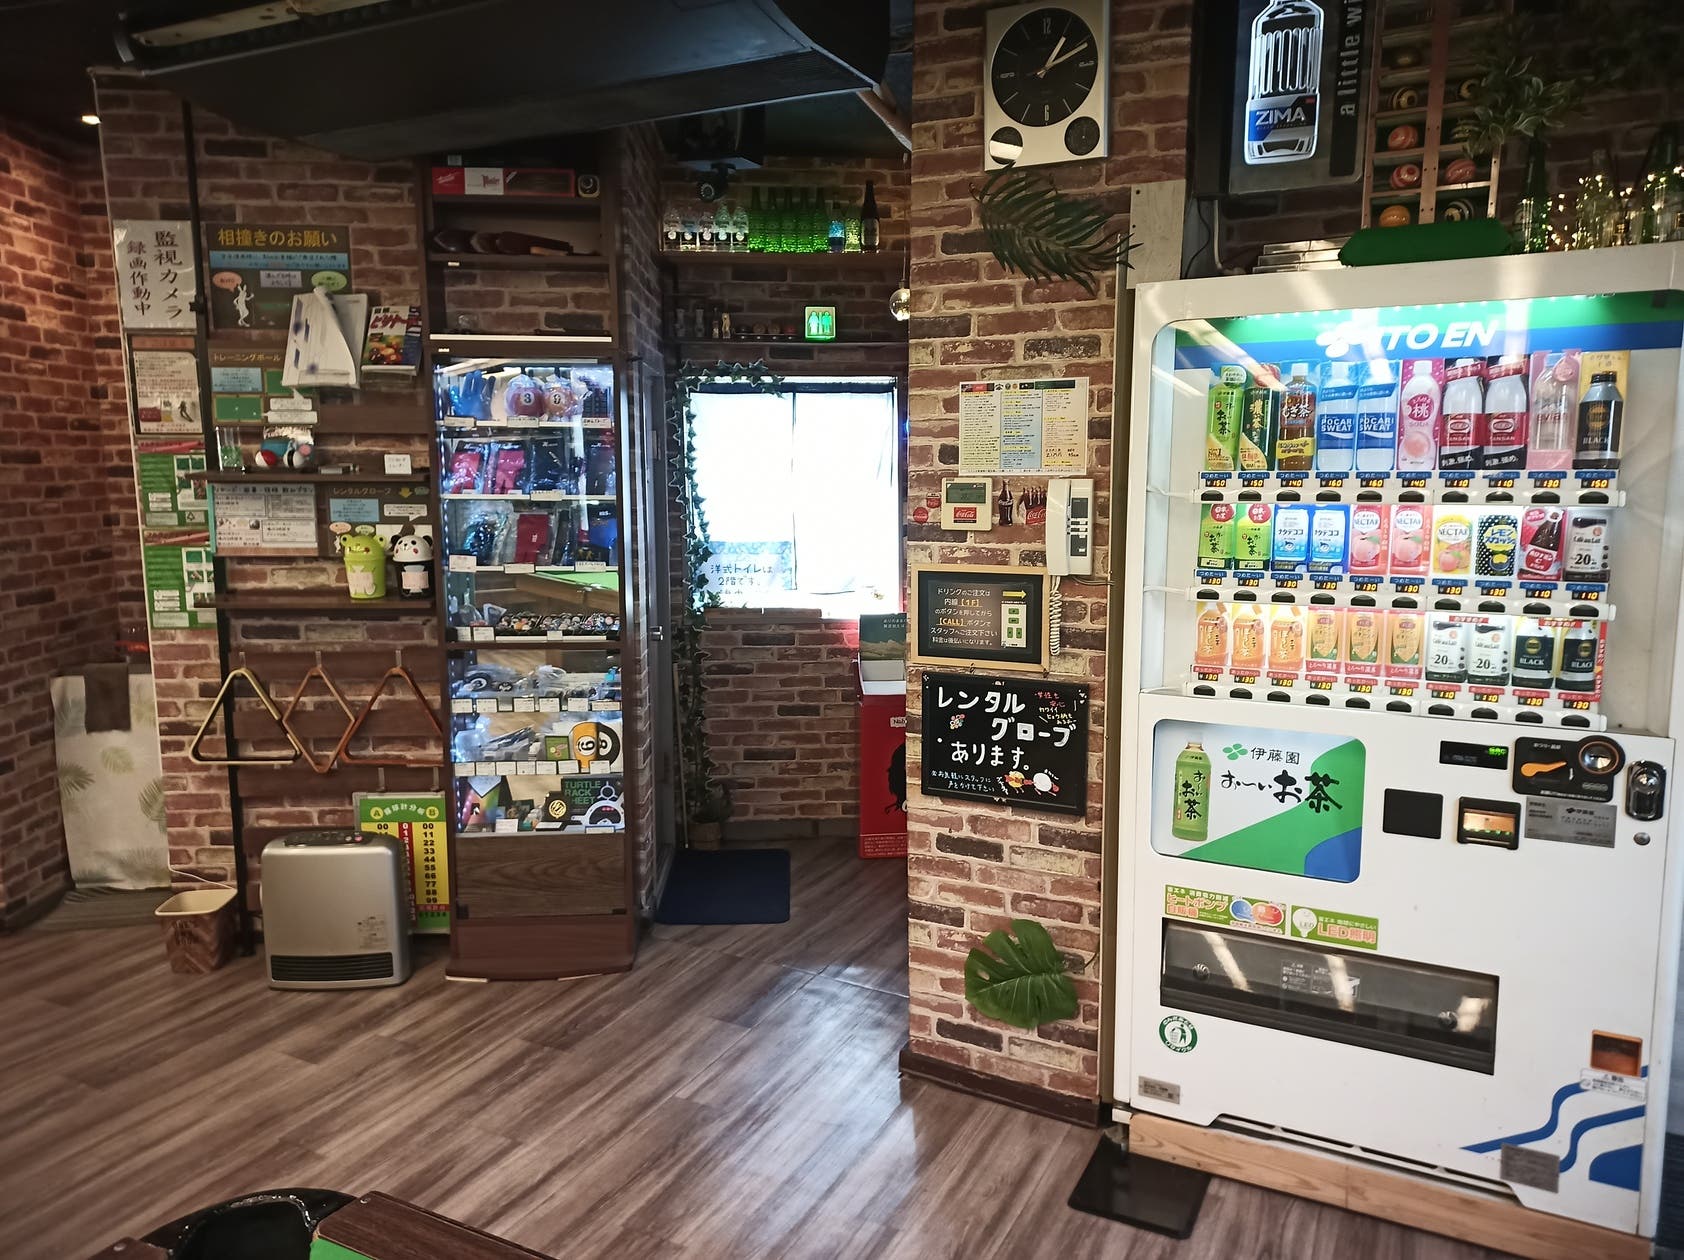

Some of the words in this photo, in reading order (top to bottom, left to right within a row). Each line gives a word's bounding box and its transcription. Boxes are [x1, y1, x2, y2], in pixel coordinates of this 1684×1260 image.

[1337, 35, 1360, 97] little
[1256, 106, 1306, 126] ZIMA
[217, 228, 337, 247] 相撞きのお願い
[127, 240, 152, 316] 録画作動中
[153, 229, 183, 321] 監視カメラ
[1440, 320, 1500, 348] EN
[1413, 403, 1429, 418] 桃
[710, 563, 774, 574] 洋式トイレは
[1575, 553, 1592, 565] 20
[1434, 654, 1448, 665] 20
[1476, 658, 1491, 669] 20
[1519, 658, 1544, 666] BLACK
[939, 686, 1026, 714] レンタル
[991, 716, 1077, 748] グローブ
[951, 741, 1030, 770] あります。
[1250, 746, 1301, 765] 伊藤園
[564, 780, 601, 789] TURTLE
[564, 788, 592, 797] RACK
[1220, 769, 1343, 814] お〜いお茶
[572, 796, 595, 805] HEET
[1181, 780, 1202, 820] お茶
[425, 872, 437, 880] 66
[1166, 892, 1229, 912] ヒートポンプ
[1317, 922, 1377, 944] LED照明
